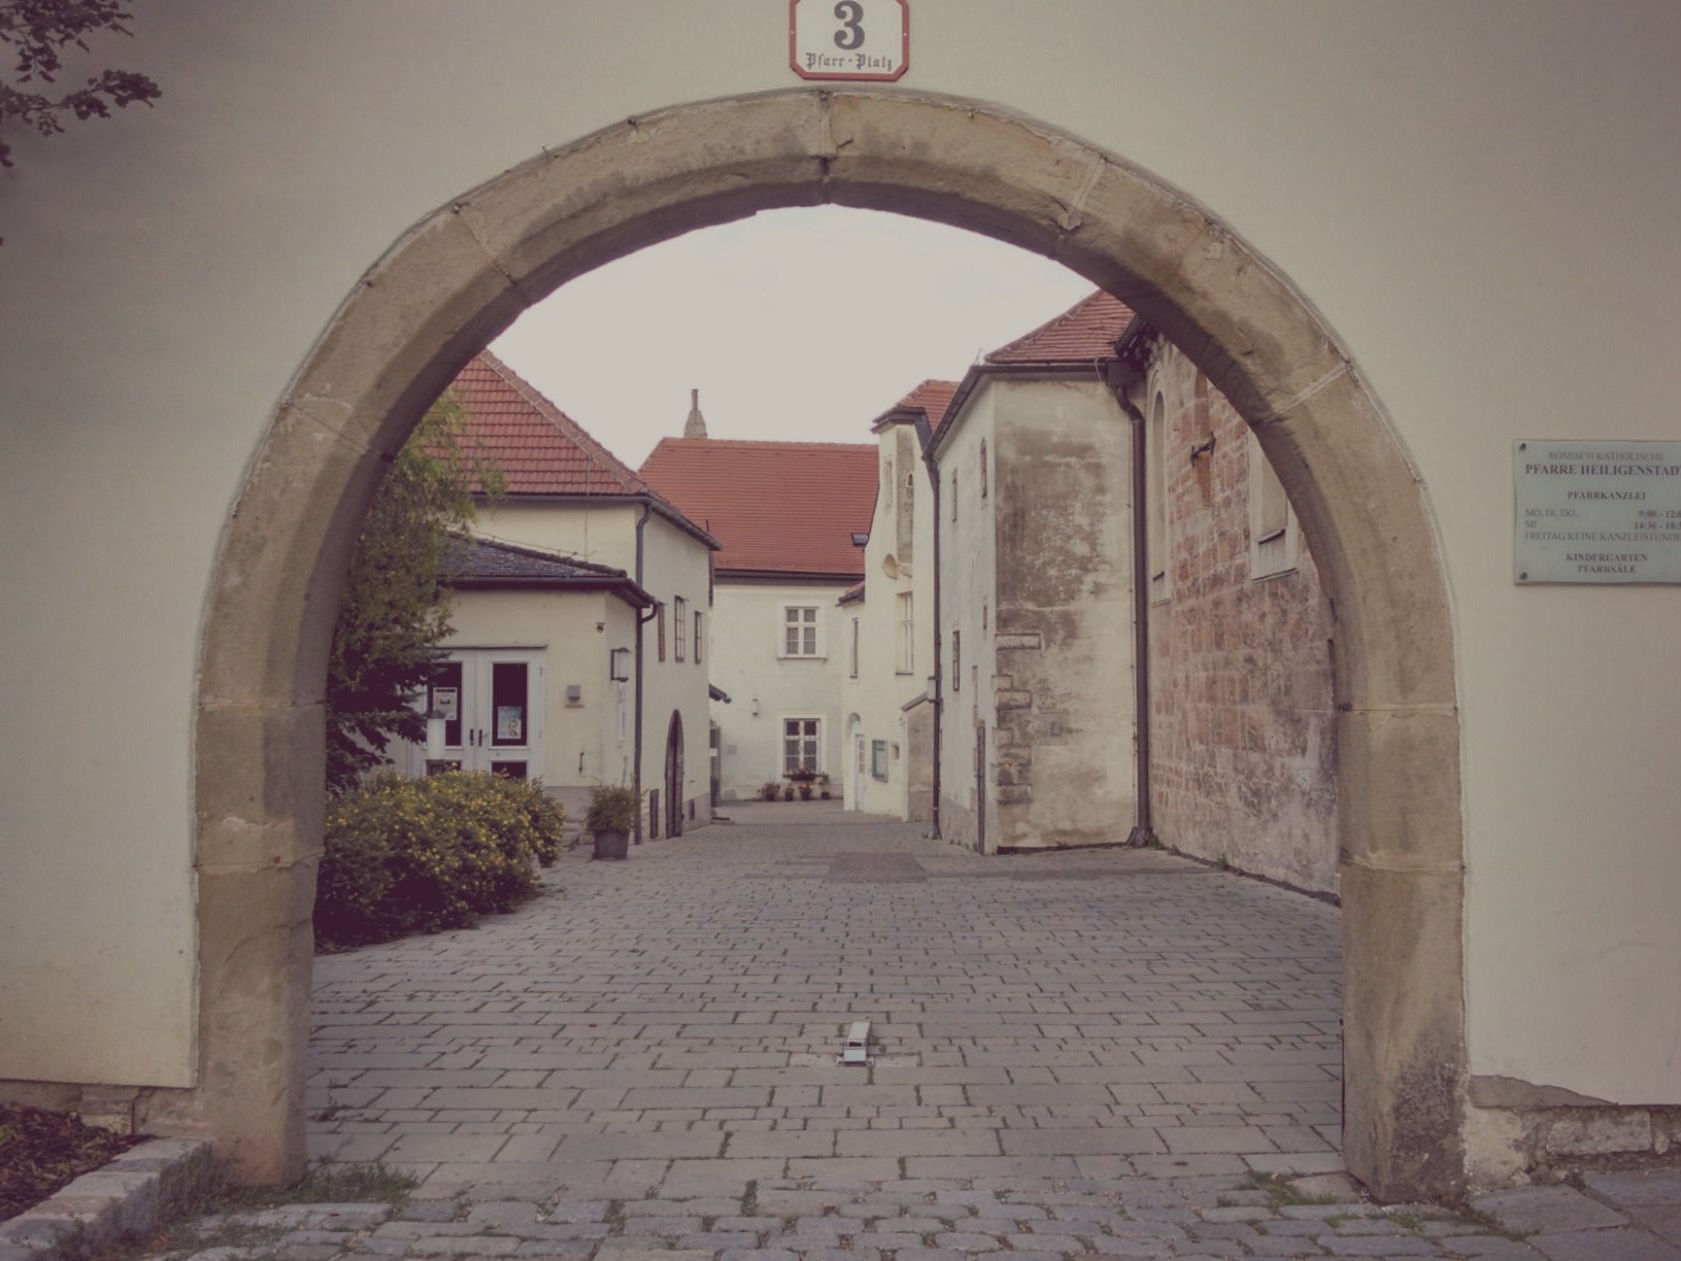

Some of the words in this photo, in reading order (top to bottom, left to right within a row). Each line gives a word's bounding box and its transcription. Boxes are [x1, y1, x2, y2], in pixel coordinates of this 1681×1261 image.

[834, 0, 865, 50] 3
[1596, 451, 1664, 461] KATHOLISCHE
[1525, 464, 1577, 475] PFARRE
[1581, 464, 1681, 476] HEILIGENSTAD
[1568, 491, 1646, 500] PFARRKANZLEI
[1525, 532, 1565, 541] FREITAG
[1568, 532, 1596, 541] KEINE
[1566, 553, 1647, 561] KINDERGARTEN
